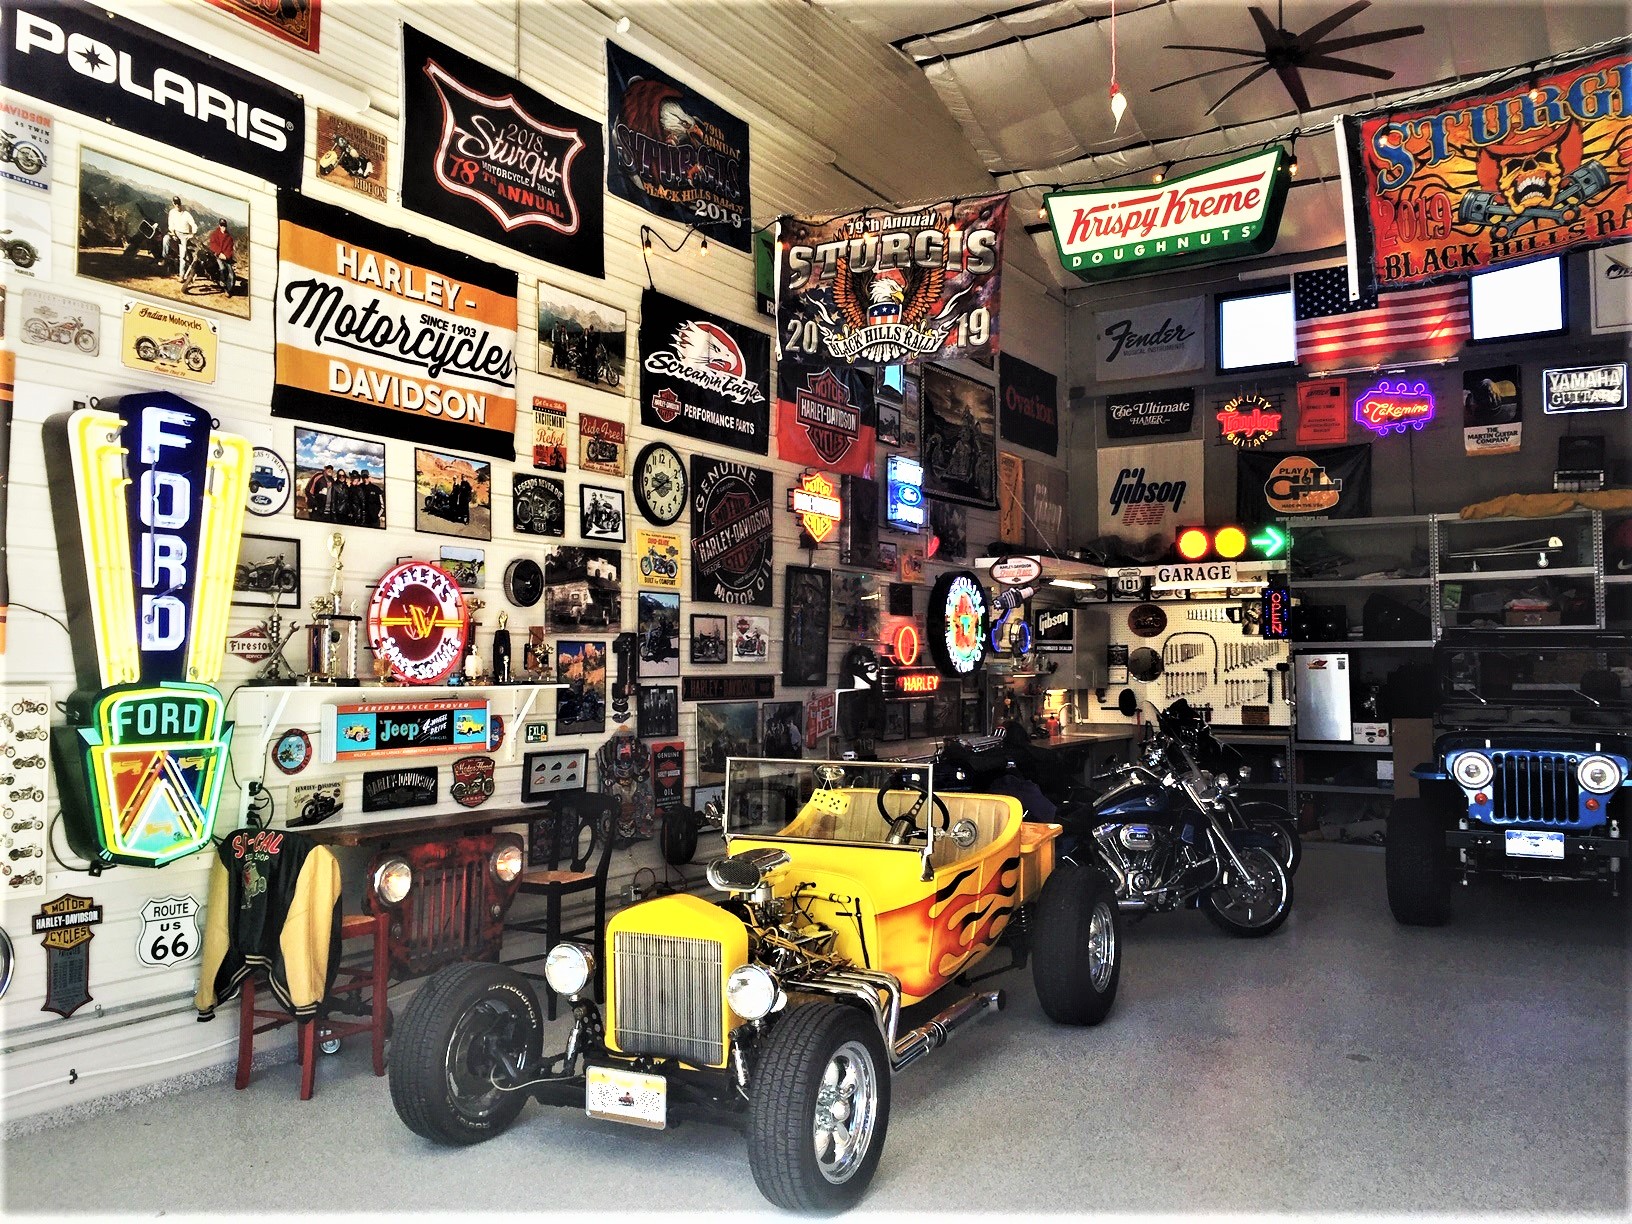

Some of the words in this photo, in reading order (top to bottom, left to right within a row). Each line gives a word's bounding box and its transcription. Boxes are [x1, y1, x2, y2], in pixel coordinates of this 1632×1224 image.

[16, 9, 287, 152] POLARIS
[27, 125, 50, 137] TWIN
[31, 134, 50, 145] WLD
[506, 123, 543, 152] 2018
[704, 121, 725, 141] 79th
[454, 115, 562, 188] Sturgis
[704, 134, 741, 160] ANNUAL
[617, 123, 740, 199] STURGIS
[354, 178, 372, 194] RIDE
[449, 155, 479, 185] 78
[497, 186, 564, 218] ANNUAL
[482, 161, 529, 186] MOTORCYCLE
[537, 182, 556, 198] RALLY
[644, 182, 679, 203] BLACK
[682, 188, 712, 203] HILLS
[713, 194, 744, 215] RALLY
[1067, 192, 1165, 246] Krispy
[1158, 171, 1266, 228] Kreme
[695, 199, 742, 229] 2019
[882, 213, 935, 230] Annual
[1377, 192, 1453, 249] 2019
[1072, 225, 1251, 268] DOUGHNUTS
[1384, 242, 1481, 281] BLACK
[1490, 222, 1587, 260] HILLS
[789, 228, 997, 290] STURGIS
[139, 307, 167, 323] Indian
[168, 314, 203, 331] Motocycles
[285, 278, 515, 380] Motorcycles
[420, 314, 450, 331] SINCE
[451, 323, 477, 338] 1903
[956, 308, 991, 348] 19
[785, 319, 818, 354] 20
[831, 336, 862, 357] BLACK
[864, 324, 902, 345] HILLS
[905, 331, 942, 353] RALLY
[1105, 318, 1195, 362] Fender
[1123, 348, 1146, 357] MUSICAL
[1147, 342, 1185, 354] INSTRUMENTS
[721, 376, 762, 404] Eagle
[1549, 366, 1623, 391] YAMAHA
[328, 360, 487, 425] DAVIDSON
[815, 378, 846, 404] MOTOR
[1552, 387, 1621, 405] GUITARS
[801, 398, 857, 431] HARLEY-DAVIDSON
[1006, 385, 1055, 425] Ovation
[1110, 403, 1133, 420] The
[1133, 401, 1190, 415] Ultimate
[1224, 394, 1272, 413] QUALITY
[1363, 401, 1428, 423] Takamine
[535, 412, 565, 429] EXCITEMENT
[581, 417, 600, 434] Ride
[601, 422, 624, 441] Free!
[684, 404, 735, 429] PERFORMANCE
[735, 418, 755, 435] PARTS
[1130, 415, 1164, 426] HAMER
[1216, 408, 1282, 437] Taylor
[536, 428, 565, 446] Rebel
[813, 429, 845, 456] CYCLES
[1468, 433, 1493, 441] MARTIN
[1476, 437, 1510, 445] COMPANY
[514, 478, 537, 496] LEGENDS
[538, 478, 554, 492] NEVER
[554, 488, 563, 501] DIE
[696, 462, 757, 513] GENUINE
[1110, 468, 1186, 516] Gibson
[255, 496, 268, 505] Ford
[140, 407, 196, 651] FORD
[698, 506, 771, 564] HARLEY-DAVIDSON
[703, 561, 722, 577] TRADE
[714, 583, 755, 605] MOTOR
[756, 555, 773, 591] OIL
[1159, 566, 1231, 582] GARAGE
[1121, 580, 1138, 589] 101
[1039, 611, 1069, 635] Gibson
[1271, 592, 1283, 634] OPEN
[903, 675, 940, 692] HARLEY
[358, 704, 429, 712] PERFORMANCE
[818, 695, 834, 711] FUEL
[117, 703, 203, 736] FORD
[430, 722, 447, 735] DRIVE
[528, 725, 545, 736] FXLR
[657, 751, 680, 759] GENUINE
[295, 782, 341, 793] HARLEY-DAVIDSON
[366, 773, 438, 797] HARLEY-DAVIDSON
[664, 788, 674, 796] OIL
[254, 853, 270, 861] SHOP
[52, 897, 85, 912] MOTOR
[153, 902, 189, 917] ROUTE
[35, 910, 99, 930] HARLEY-DAVIDSON
[160, 922, 181, 931] US
[50, 926, 87, 944] CYCLES
[151, 933, 189, 961] 66
